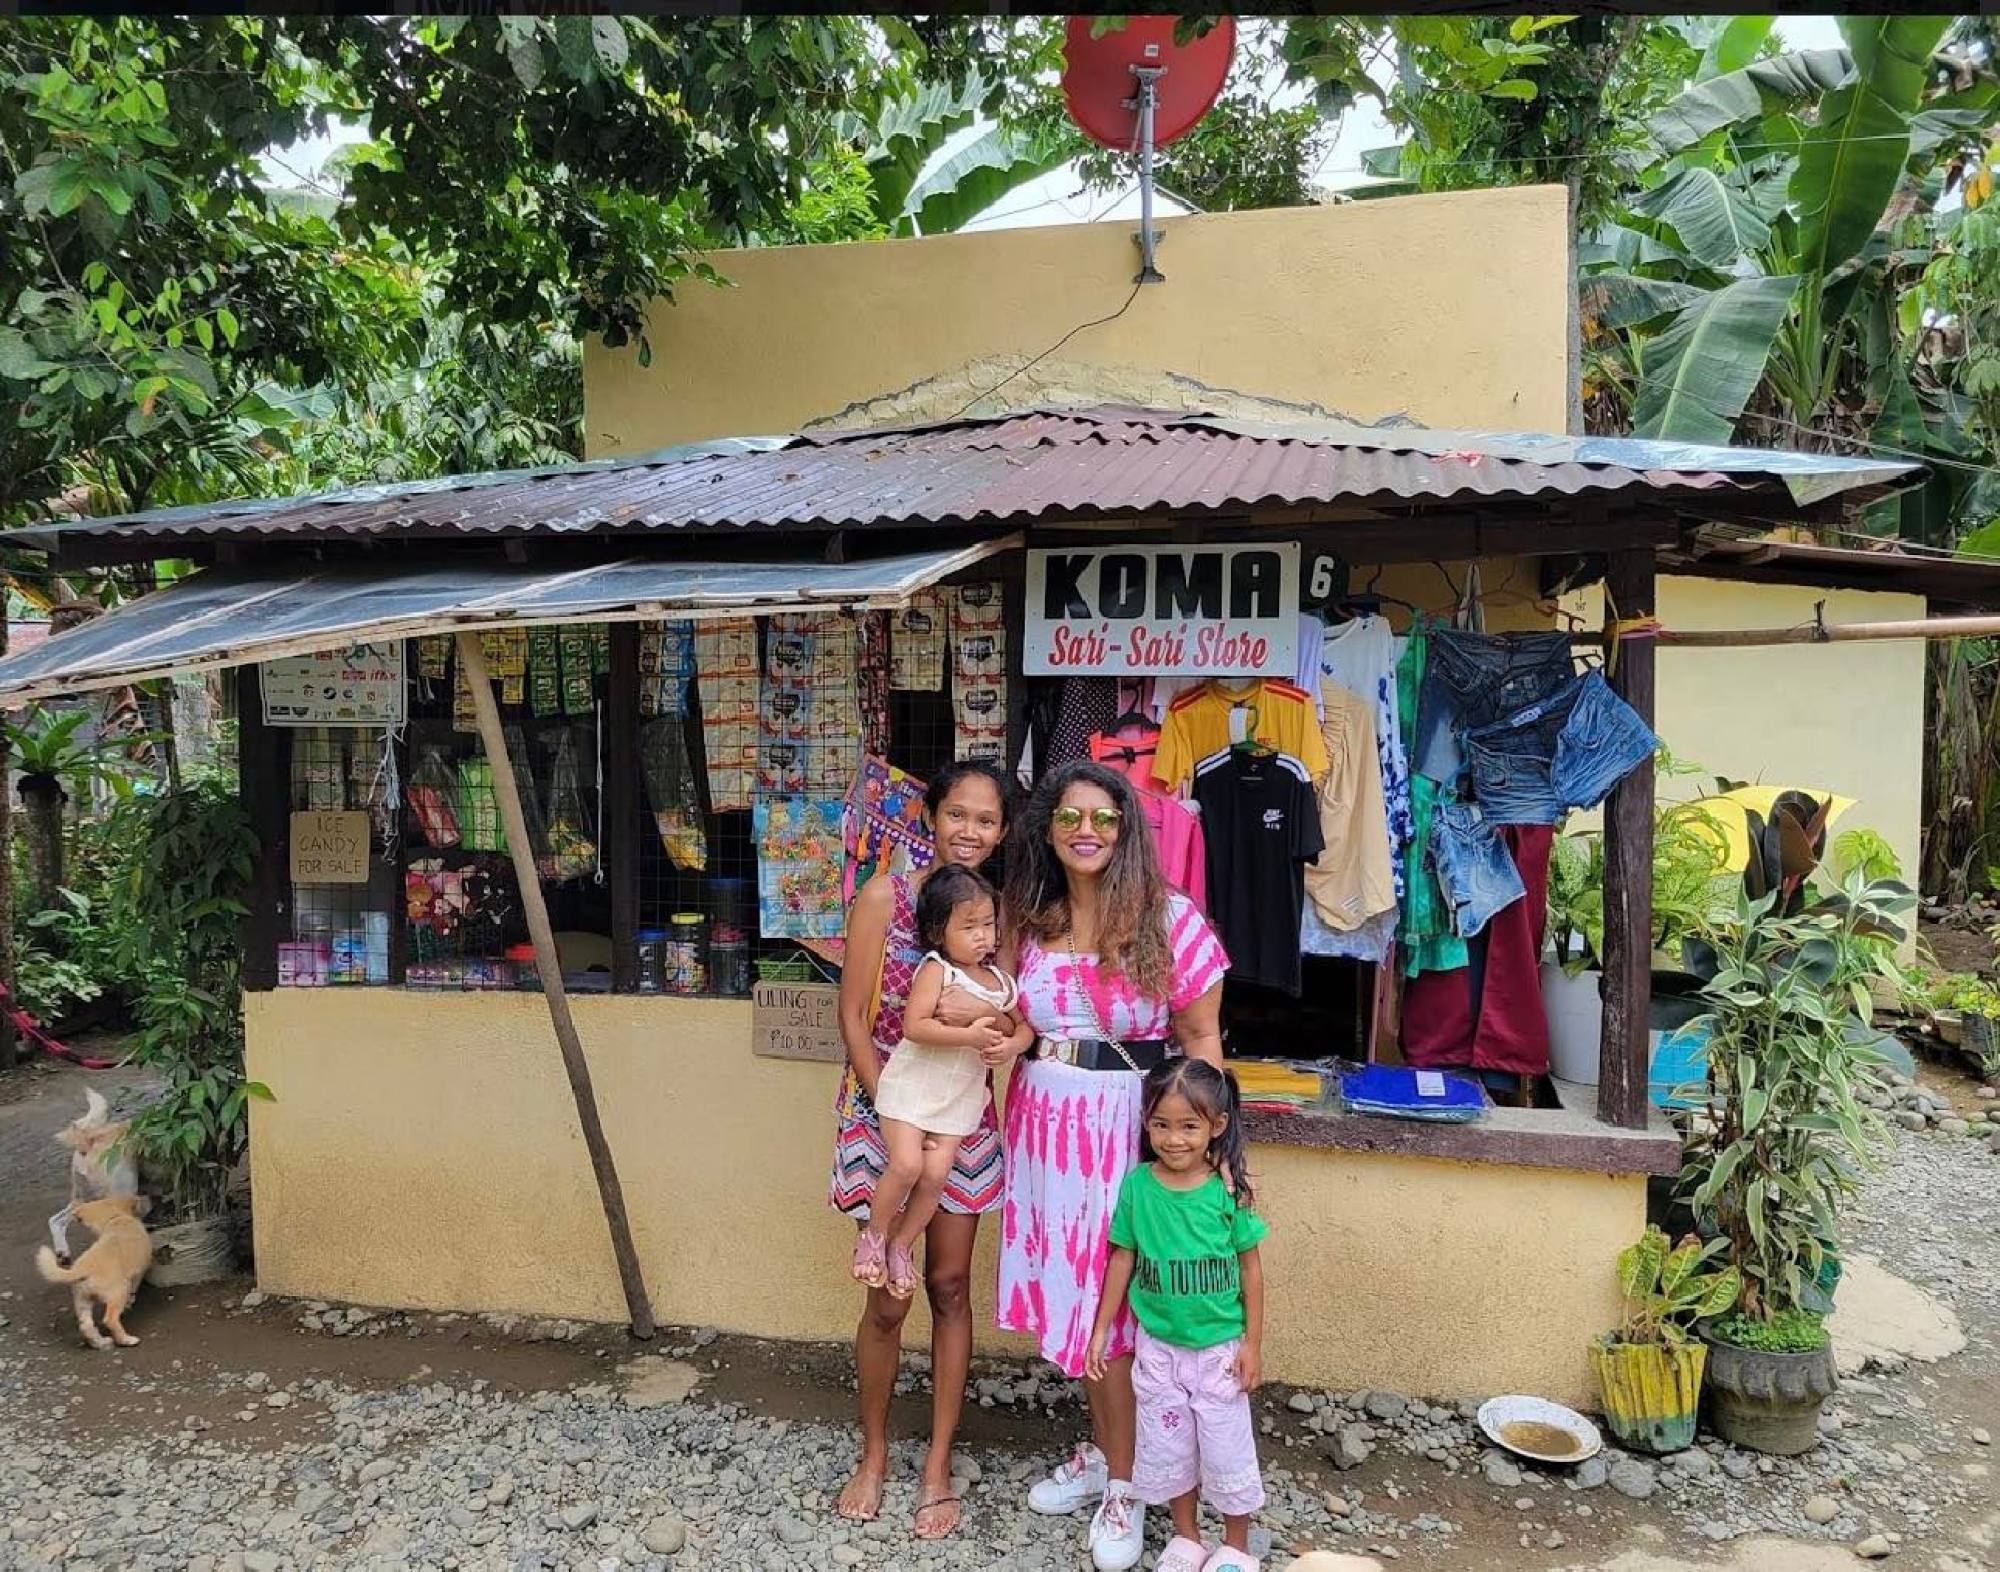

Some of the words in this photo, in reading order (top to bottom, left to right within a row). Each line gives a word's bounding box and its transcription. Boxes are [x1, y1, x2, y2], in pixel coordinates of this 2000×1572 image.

[1044, 551, 1281, 619] KOMA
[1309, 555, 1334, 598] 6
[1192, 621, 1268, 669] Store
[317, 816, 345, 833] ICE
[299, 834, 360, 854] CANDY
[298, 860, 322, 875] FOR
[327, 859, 361, 874] SALE
[757, 989, 807, 1009] ULING
[788, 1010, 823, 1028] SALE
